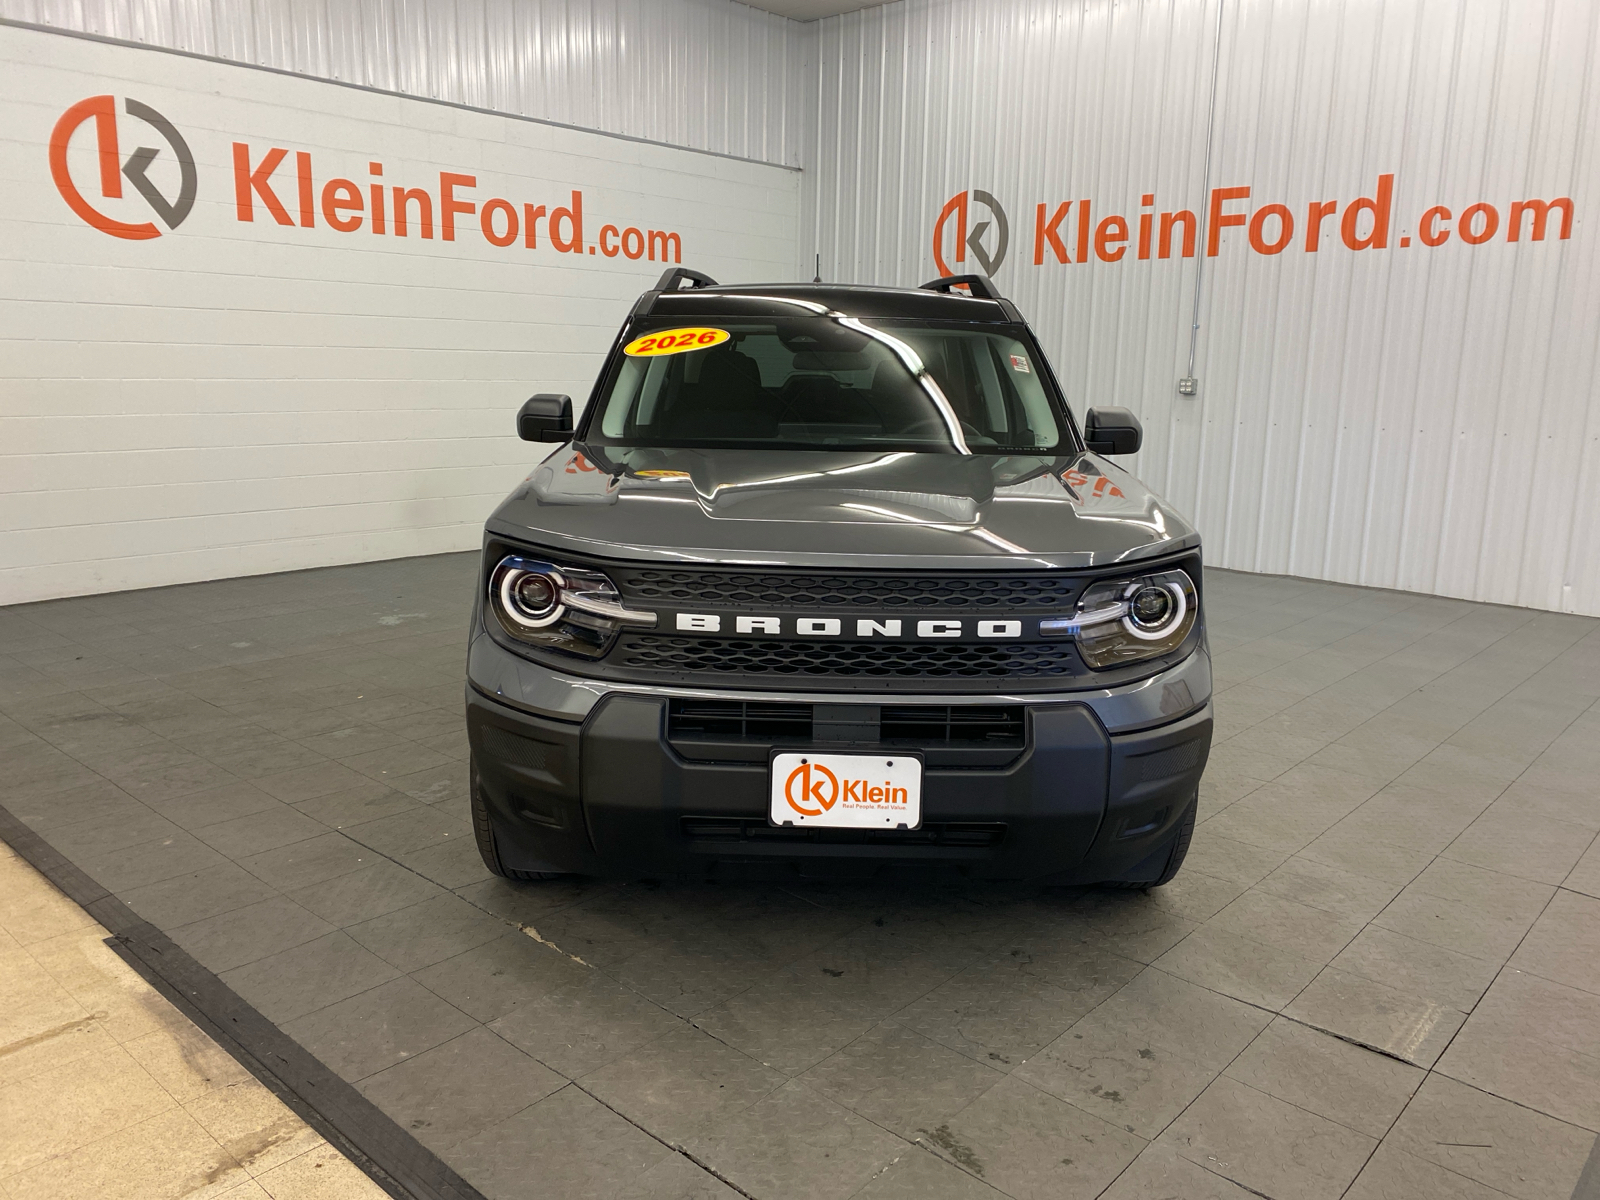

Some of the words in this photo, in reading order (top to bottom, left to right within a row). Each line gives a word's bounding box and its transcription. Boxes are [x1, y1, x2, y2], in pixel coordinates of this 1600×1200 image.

[232, 142, 682, 264] KleinFord.com
[1033, 173, 1574, 266] KleinFord.com
[635, 331, 718, 353] 2026
[676, 613, 1022, 638] BRONCO
[843, 779, 908, 804] Klein
